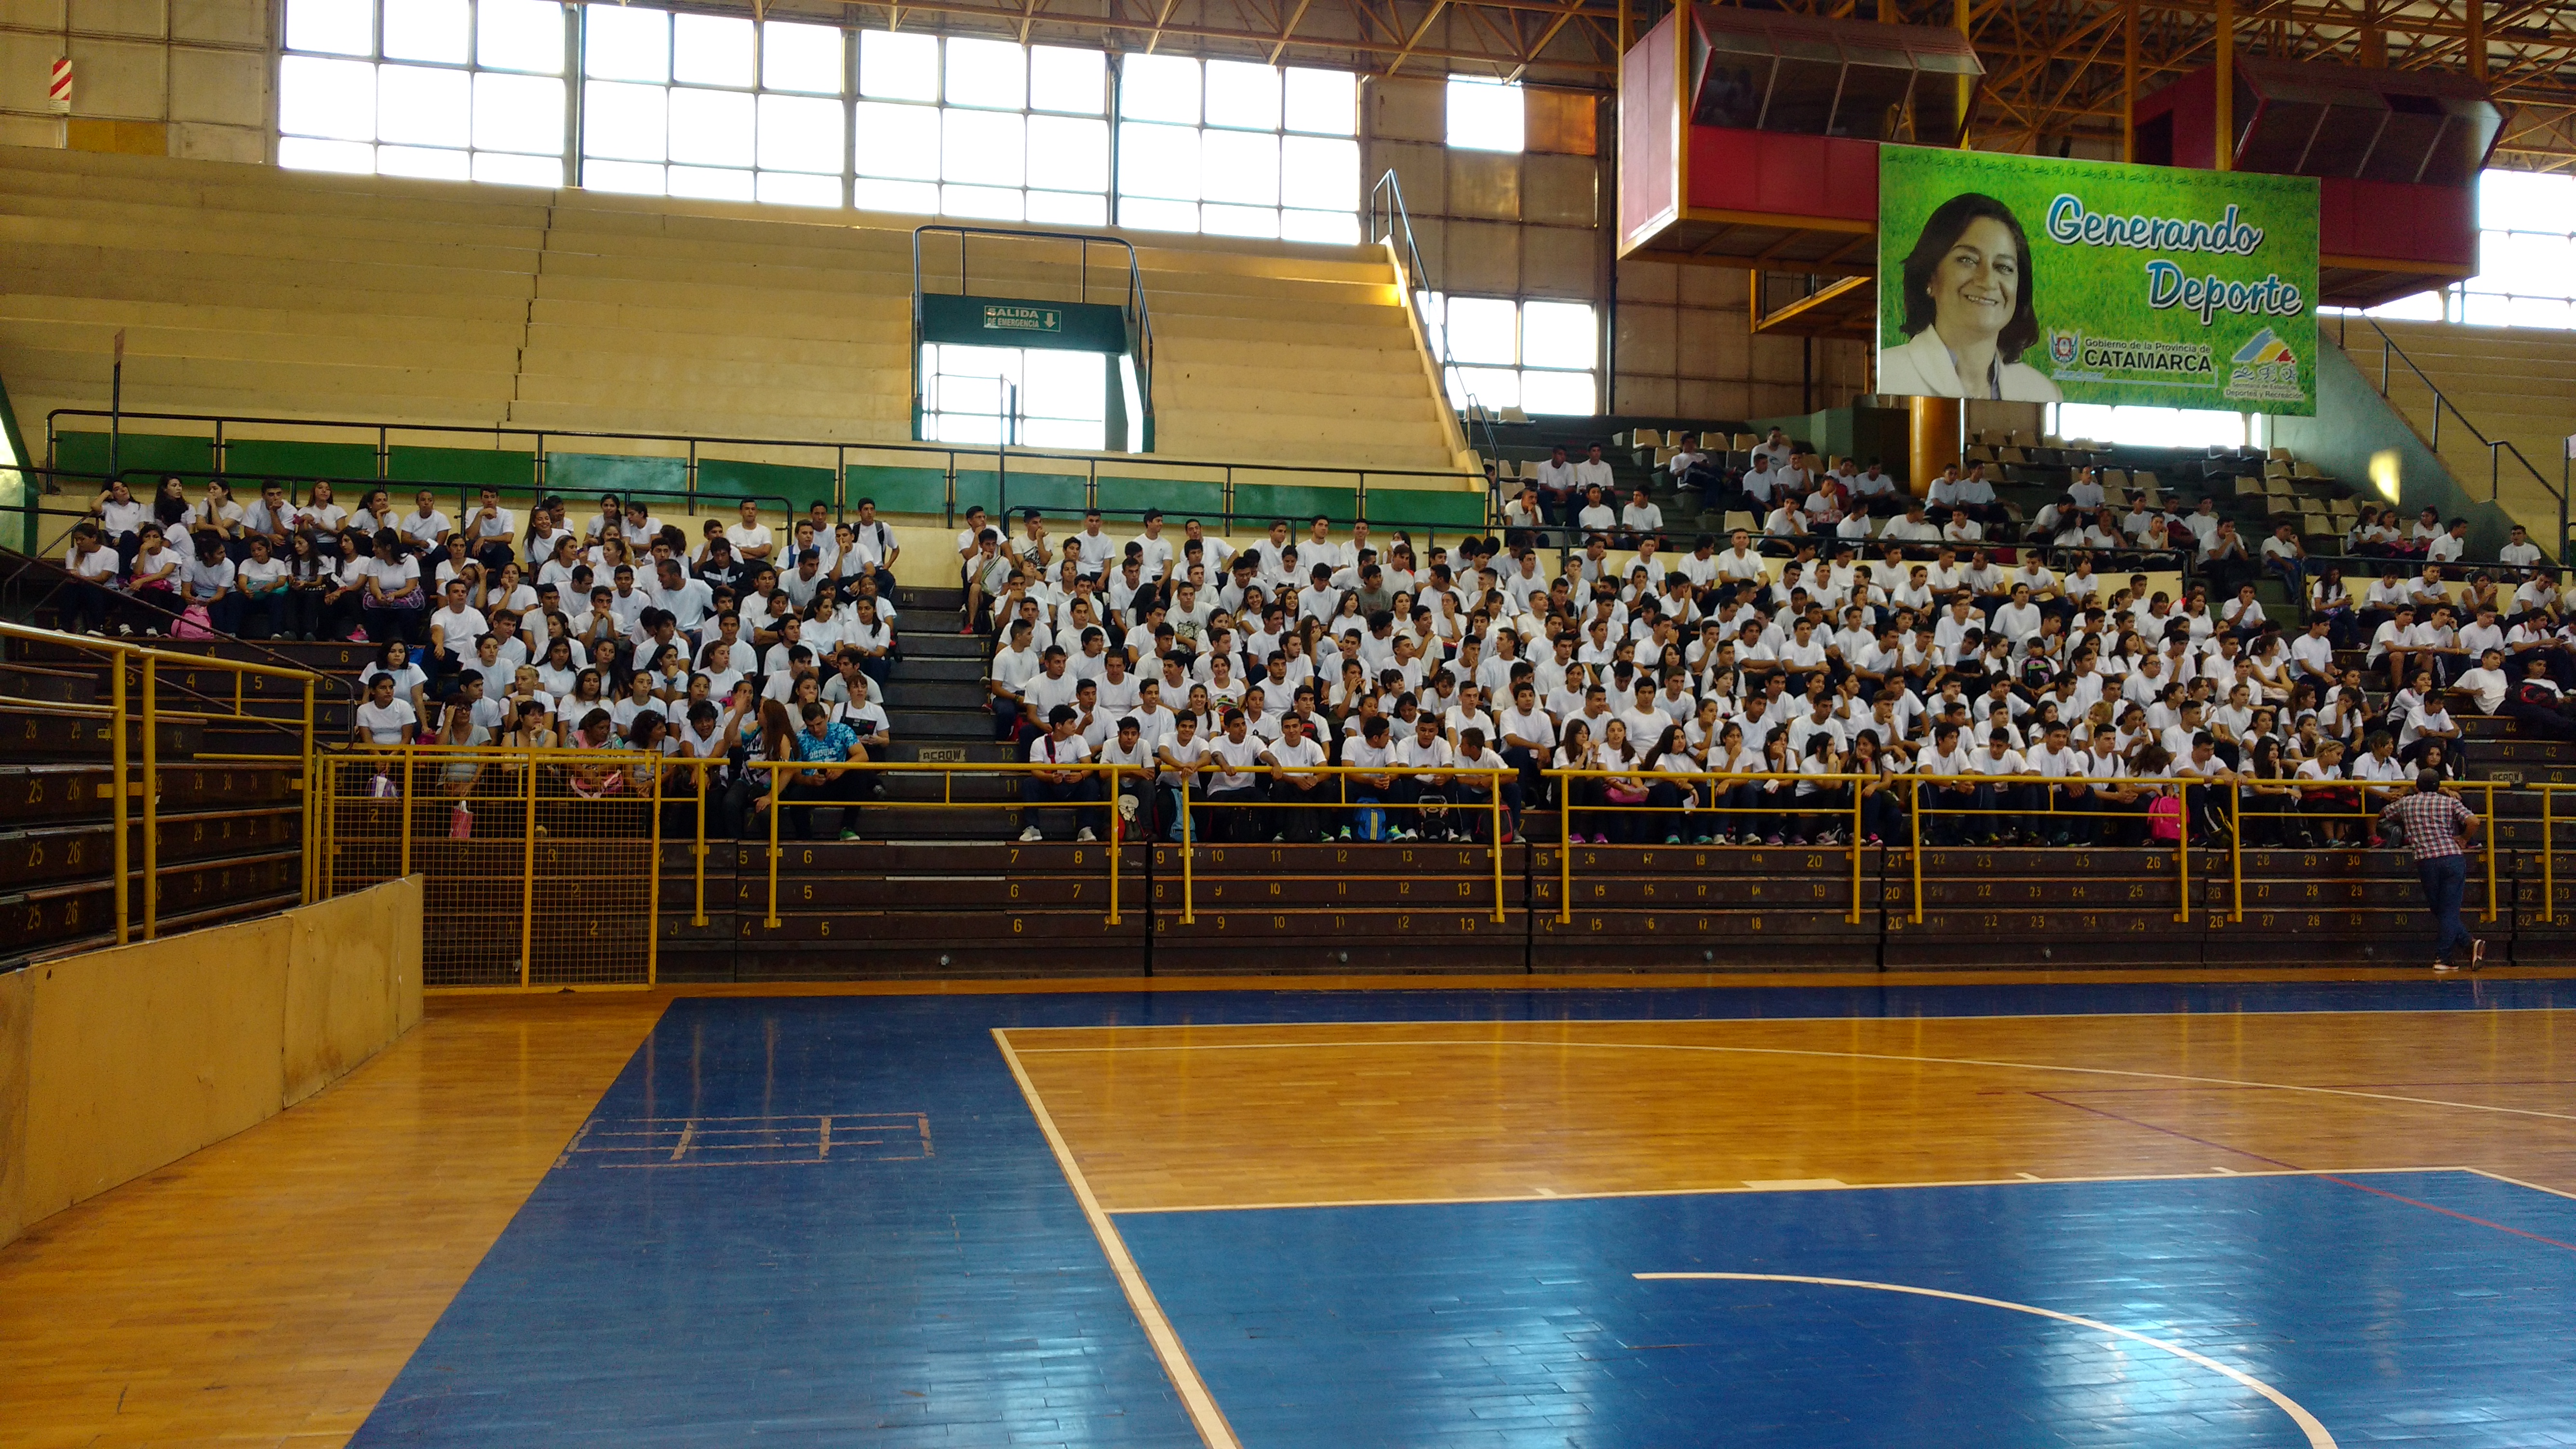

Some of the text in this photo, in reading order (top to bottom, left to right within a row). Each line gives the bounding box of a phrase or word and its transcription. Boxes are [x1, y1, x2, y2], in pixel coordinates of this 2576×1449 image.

[2046, 193, 2263, 255] Generando
[2146, 260, 2303, 325] Deporte
[987, 309, 1038, 318] SALIDA
[998, 319, 1039, 328] EMERGENCIA
[2085, 338, 2126, 349] Gobierno
[2130, 340, 2141, 349] de
[2145, 341, 2152, 350] la
[2156, 343, 2196, 352] Provincia
[2085, 349, 2212, 372] CATAMARCA
[340, 650, 349, 663] 6
[186, 673, 196, 688] 4
[255, 676, 263, 690] 5
[325, 678, 334, 691] 6
[324, 711, 332, 723] 4
[1001, 748, 1014, 760] 12
[27, 778, 43, 804] 25
[67, 778, 79, 801] 26
[1009, 813, 1019, 826] 9
[27, 841, 43, 867] 25
[67, 841, 80, 865] 26
[739, 850, 748, 865] 5
[804, 850, 813, 864] 6
[1010, 848, 1020, 863] 7
[1074, 850, 1083, 864] 8
[1156, 850, 1165, 864] 9
[1212, 849, 1224, 862] 10
[1271, 850, 1281, 862] 11
[1337, 849, 1348, 862] 12
[1402, 850, 1413, 862] 13
[1459, 852, 1470, 865] 14
[1696, 853, 1706, 866] 18
[1932, 854, 1945, 865] 22
[1807, 855, 1823, 868] 20
[1887, 854, 1902, 868] 21
[1977, 855, 1992, 868] 23
[2146, 856, 2161, 870] 26
[2304, 854, 2317, 866] 29
[2348, 854, 2361, 867] 30
[739, 885, 749, 898] 4
[804, 885, 813, 899] 5
[1010, 884, 1019, 898] 6
[1073, 883, 1082, 899] 7
[1155, 884, 1164, 898] 8
[1269, 882, 1281, 895] 10
[1338, 882, 1347, 895] 11
[1400, 882, 1409, 894] 12
[1458, 882, 1471, 896] 13
[1536, 884, 1549, 898] 14
[1595, 885, 1605, 897] 15
[1697, 885, 1707, 897] 17
[1813, 885, 1825, 898] 19
[1885, 886, 1901, 900] 20
[2129, 885, 2144, 898] 25
[2351, 885, 2362, 897] 29
[27, 904, 41, 930] 25
[1217, 916, 1226, 930] 9
[1274, 916, 1286, 929] 10
[1398, 916, 1409, 929] 12
[1751, 917, 1761, 930] 18
[2030, 915, 2045, 928] 23
[2210, 915, 2224, 929] 26
[2262, 914, 2275, 927] 27
[2519, 915, 2531, 926] 32
[2556, 914, 2570, 926] 33
[590, 920, 599, 936] 2
[742, 921, 751, 936] 4
[821, 921, 830, 936] 5
[1013, 918, 1022, 933] 6
[1157, 918, 1166, 932] 8
[1461, 918, 1475, 931] 13
[1591, 918, 1602, 931] 15
